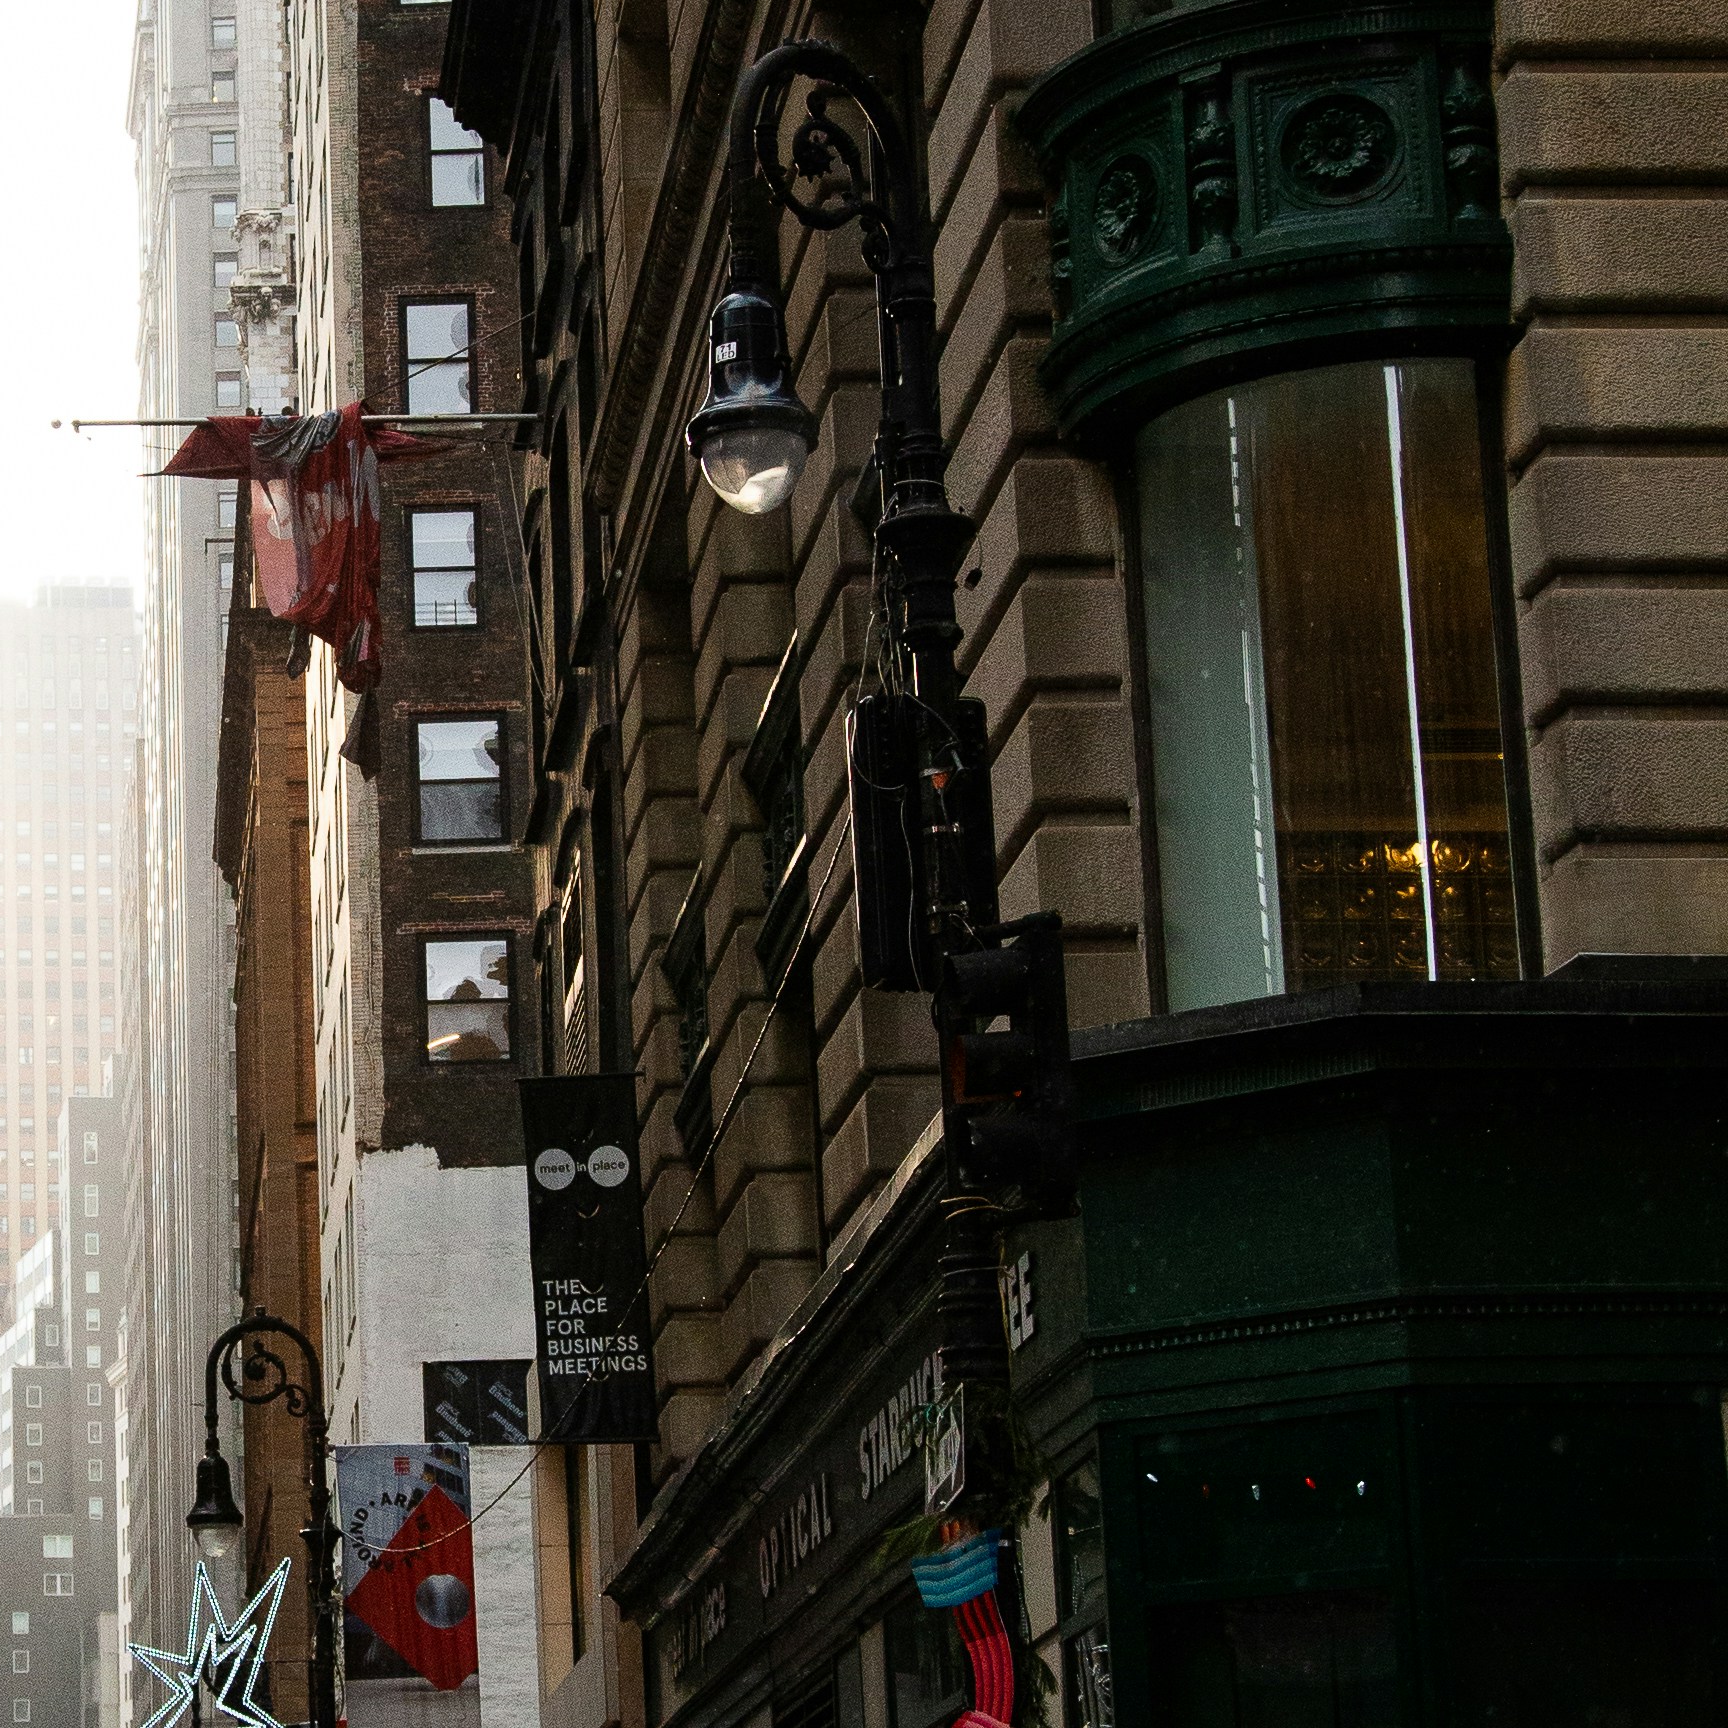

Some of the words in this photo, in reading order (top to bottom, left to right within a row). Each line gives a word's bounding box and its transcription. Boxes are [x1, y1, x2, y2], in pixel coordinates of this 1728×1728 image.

[540, 1163, 571, 1174] meet
[575, 1161, 587, 1173] in
[592, 1160, 626, 1173] place
[542, 1278, 582, 1296] THE
[544, 1297, 608, 1316] PLACE
[545, 1318, 587, 1337] FOR
[546, 1334, 640, 1356] BUSINESS
[548, 1354, 649, 1376] MEETINGS
[758, 1472, 833, 1599] OPTICAL
